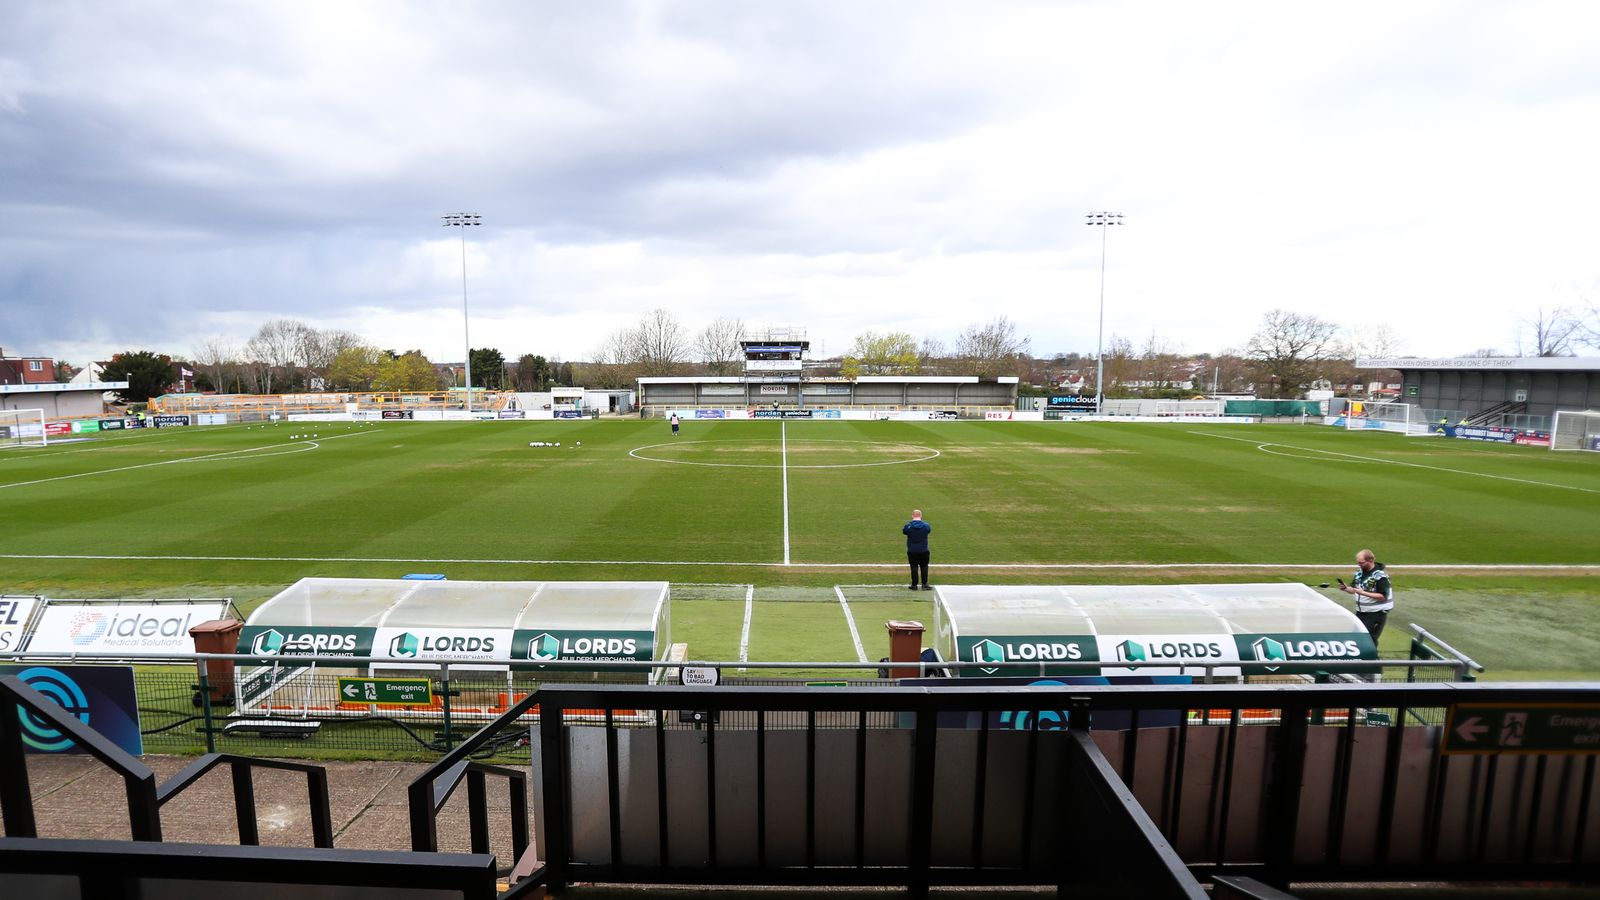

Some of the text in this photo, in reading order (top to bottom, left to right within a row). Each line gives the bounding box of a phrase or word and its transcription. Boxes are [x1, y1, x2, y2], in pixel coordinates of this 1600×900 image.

[1052, 395, 1097, 404] geniecloud
[107, 613, 192, 637] ideal
[103, 639, 183, 647] Medical Solutions
[285, 634, 357, 650] LORDS
[423, 636, 494, 652] LORDS
[563, 637, 637, 654] LORDS
[1284, 640, 1360, 657] LORDS
[1007, 643, 1081, 660] LORDS
[1149, 643, 1222, 658] LORDS
[386, 684, 426, 692] Emergency
